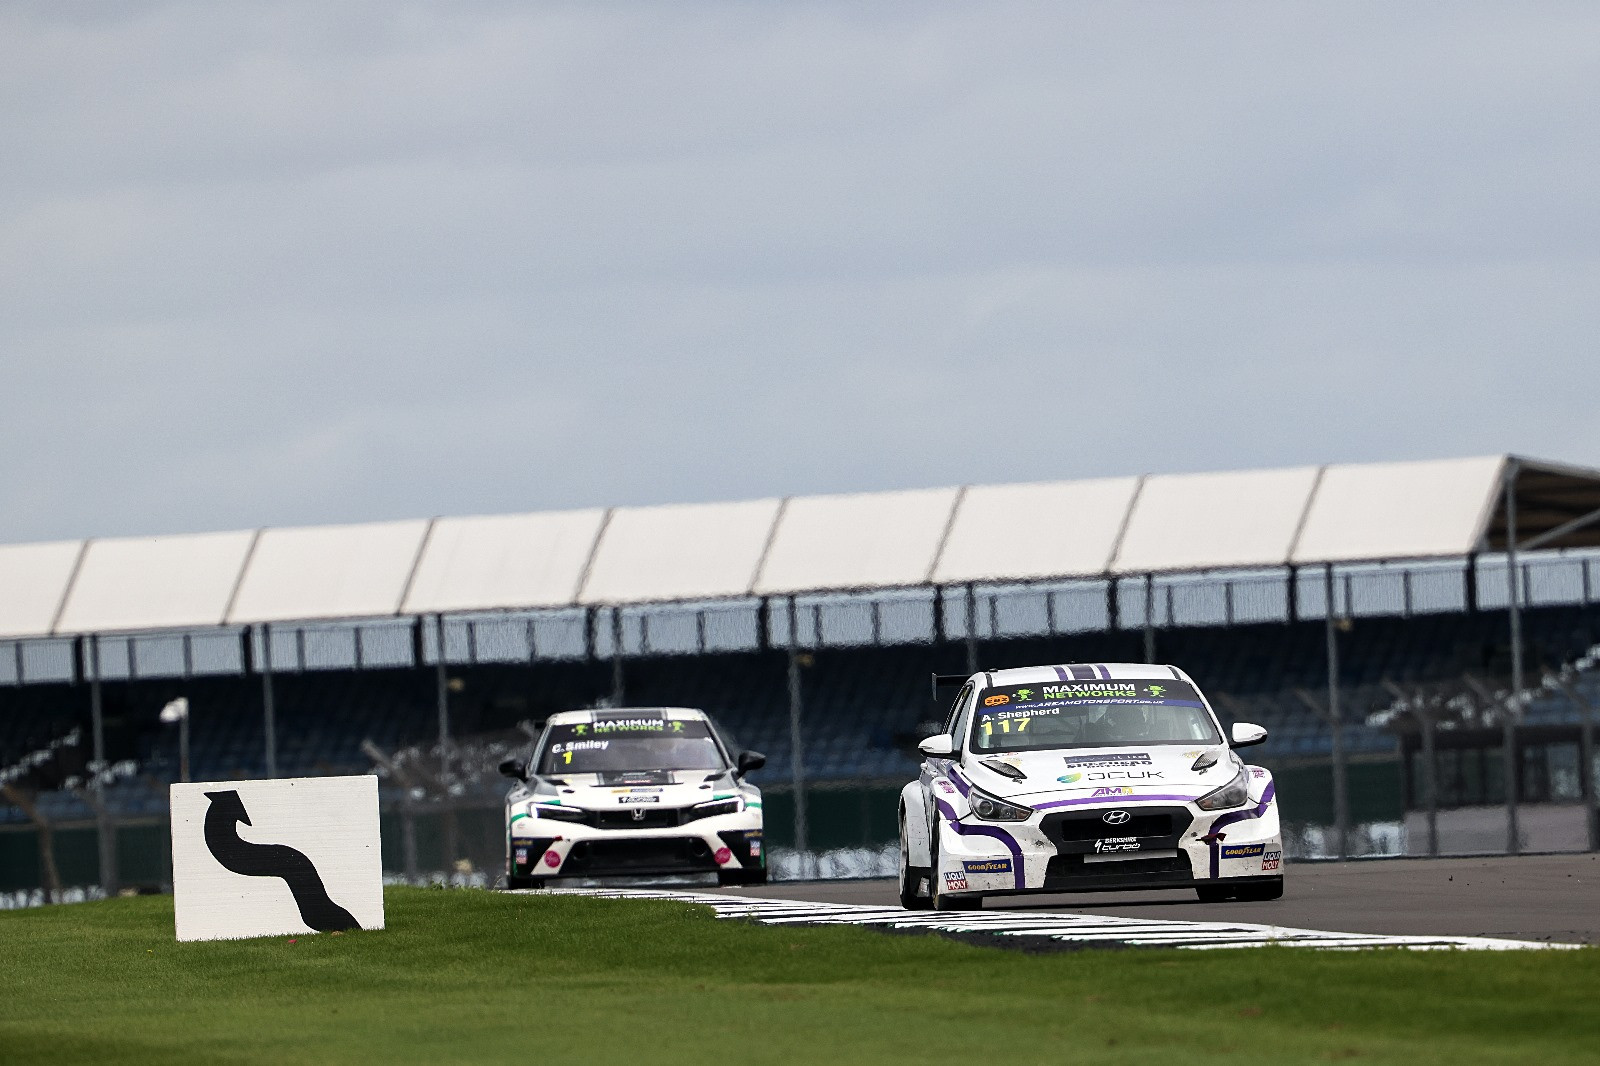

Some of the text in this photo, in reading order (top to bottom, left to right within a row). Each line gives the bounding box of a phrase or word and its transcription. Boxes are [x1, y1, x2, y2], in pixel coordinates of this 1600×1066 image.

[1042, 683, 1136, 694] MAXIMUM
[1043, 690, 1137, 700] NETWORKS
[982, 707, 1060, 722] A. Shepherd
[593, 719, 664, 729] MAXIMUM
[980, 717, 1031, 736] 117
[594, 725, 664, 734] NETWORKS
[551, 740, 609, 754] C. Smiley
[562, 751, 573, 764] 1
[1104, 836, 1137, 844] BERKSHIRE
[1225, 846, 1262, 856] GOODYEAR
[967, 862, 1008, 871] GOODYEAR
[1262, 860, 1279, 870] MOLY
[944, 871, 966, 881] LIQUI
[947, 880, 967, 890] MOLY
